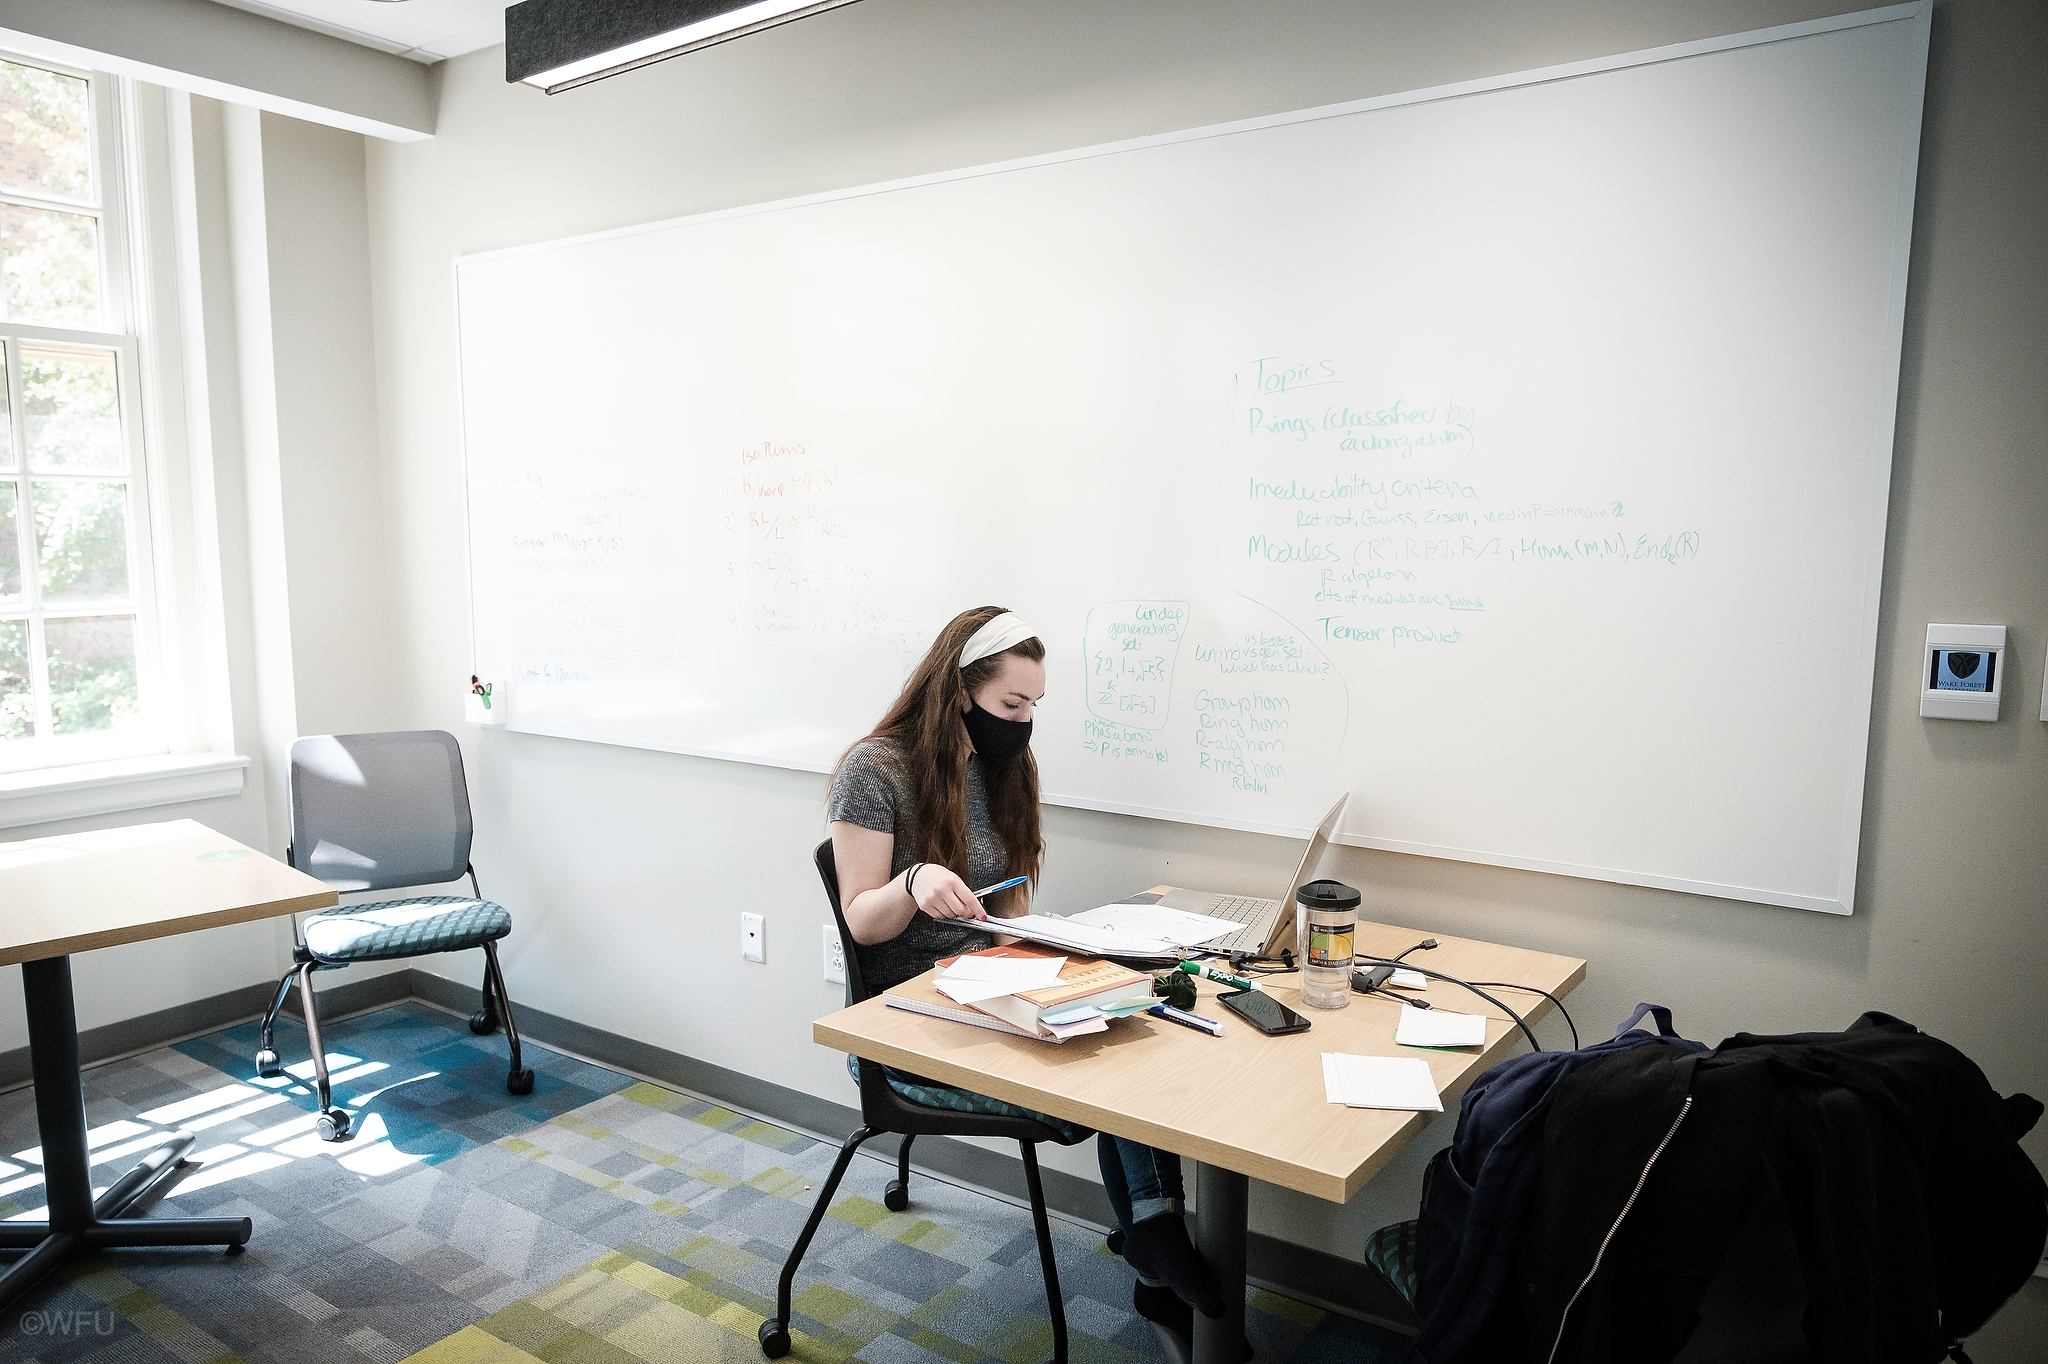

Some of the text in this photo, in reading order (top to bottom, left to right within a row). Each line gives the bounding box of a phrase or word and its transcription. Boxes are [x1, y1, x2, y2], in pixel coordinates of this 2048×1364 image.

[1250, 356, 1338, 394] Topics
[1249, 406, 1317, 442] Rings
[1447, 398, 1475, 430] by
[1391, 476, 1480, 500] criteria
[1361, 509, 1418, 529] Gauss,
[1423, 509, 1477, 527] Eisen,
[1249, 534, 1341, 564] Modules
[1321, 568, 1337, 588] R
[1316, 615, 1465, 648] Tensor product
[1194, 688, 1291, 716] Group hom
[1200, 713, 1289, 738] Ring hom
[1195, 729, 1285, 760] R-alg hom
[1200, 751, 1212, 771] R
[1250, 757, 1287, 782] hom
[1232, 776, 1243, 790] R
[1209, 969, 1234, 983] EXPO
